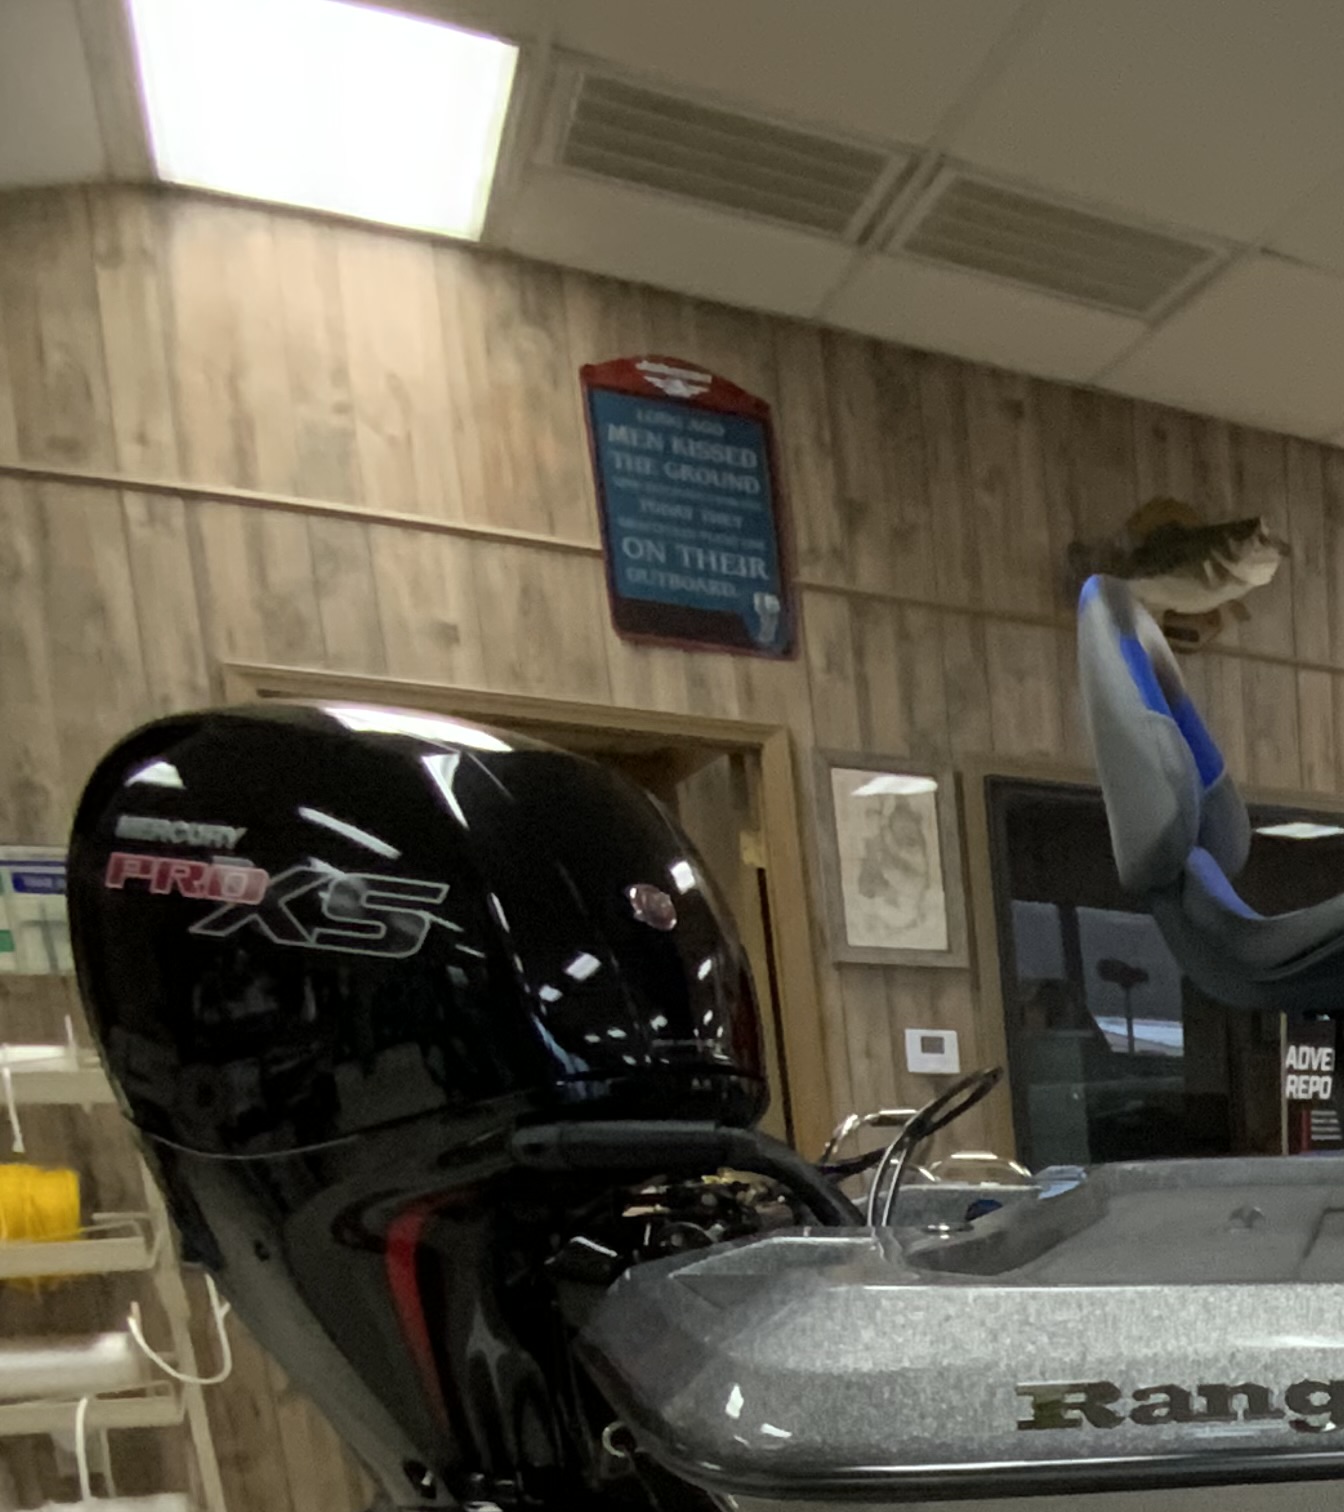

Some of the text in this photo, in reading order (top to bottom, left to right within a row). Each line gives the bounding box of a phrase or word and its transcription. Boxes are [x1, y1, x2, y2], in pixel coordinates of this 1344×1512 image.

[608, 423, 758, 469] MEN KISSED
[611, 451, 659, 477] THE
[664, 460, 761, 496] GROUND
[622, 536, 770, 580] ON THEIR
[105, 852, 450, 959] PRO XS
